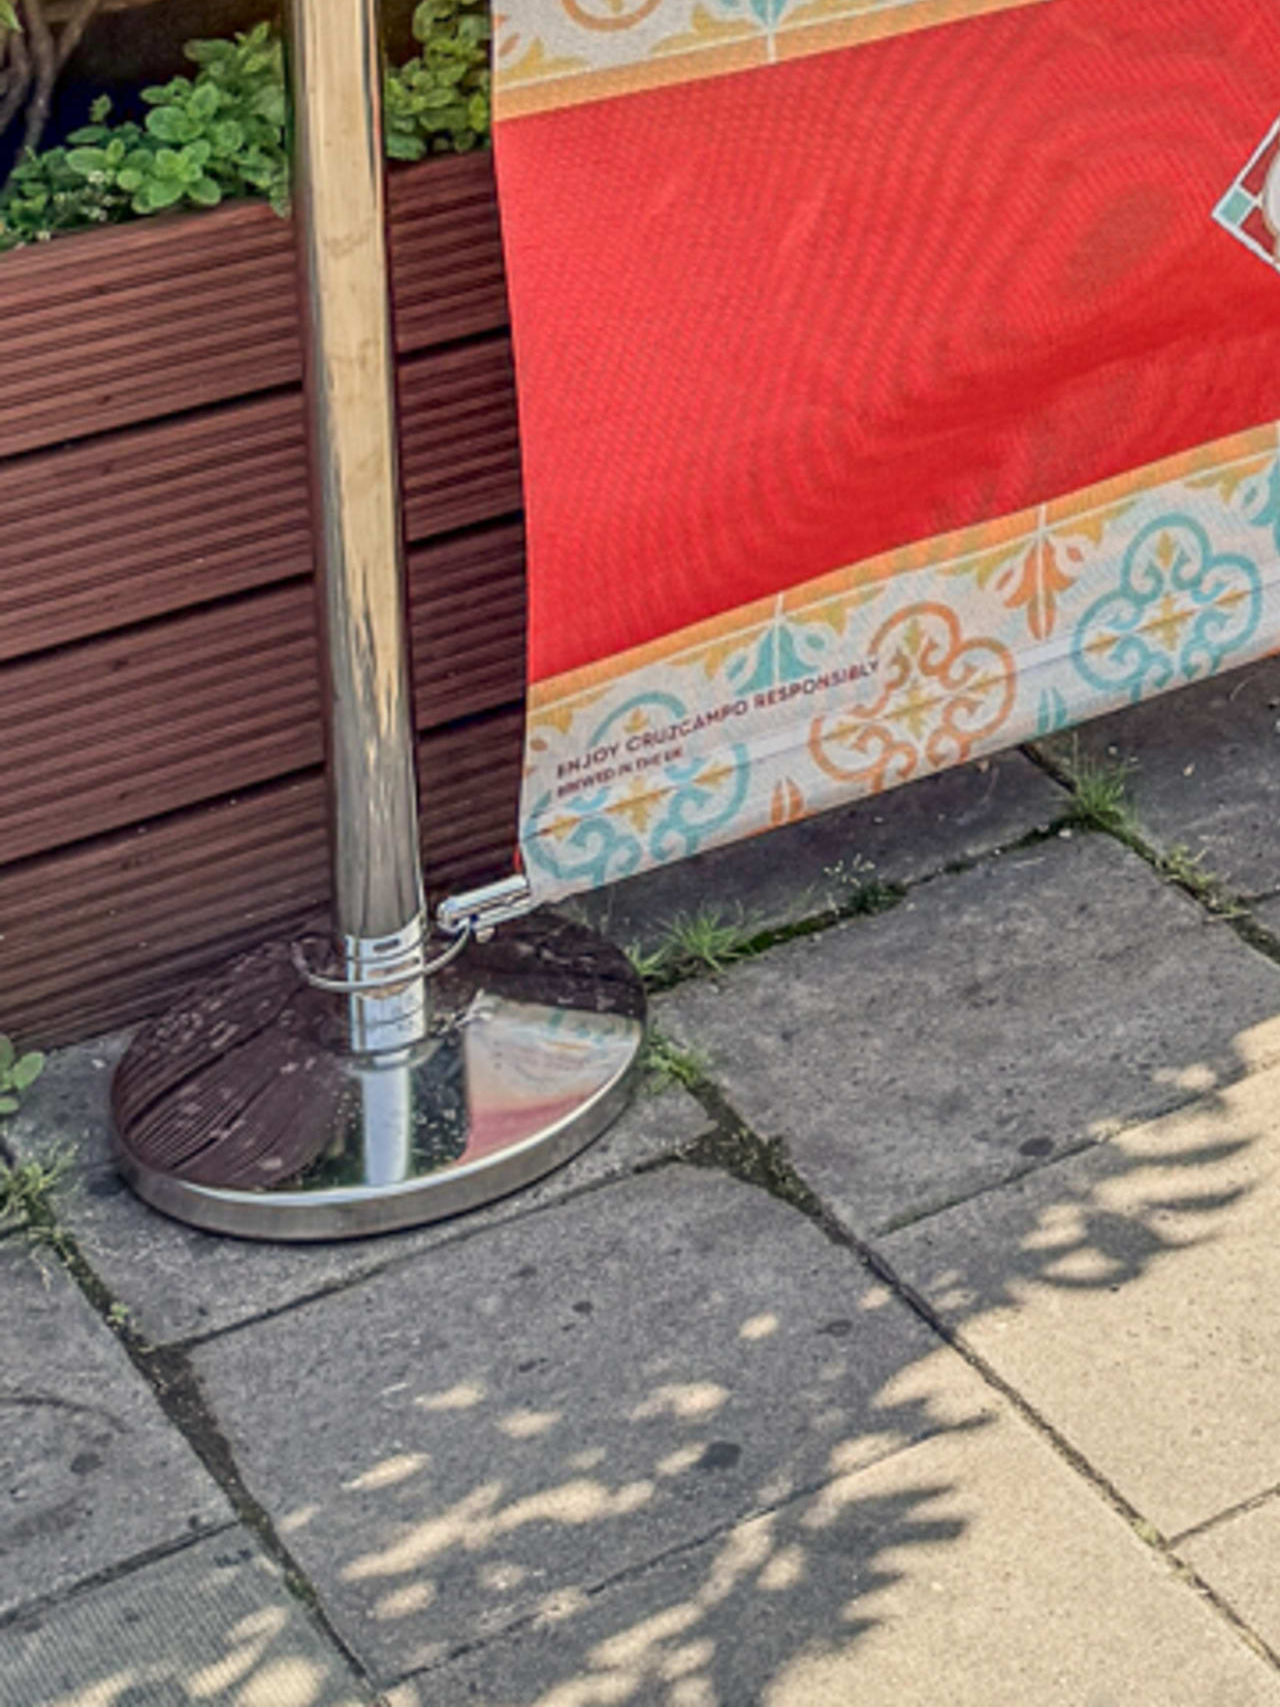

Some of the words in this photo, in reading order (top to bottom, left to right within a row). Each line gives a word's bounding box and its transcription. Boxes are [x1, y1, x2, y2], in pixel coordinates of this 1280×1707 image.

[557, 741, 619, 777] ENJOY
[626, 700, 748, 753] CRUZCAMPO
[753, 659, 880, 709] RESPONSIBLY
[636, 754, 661, 770] THE
